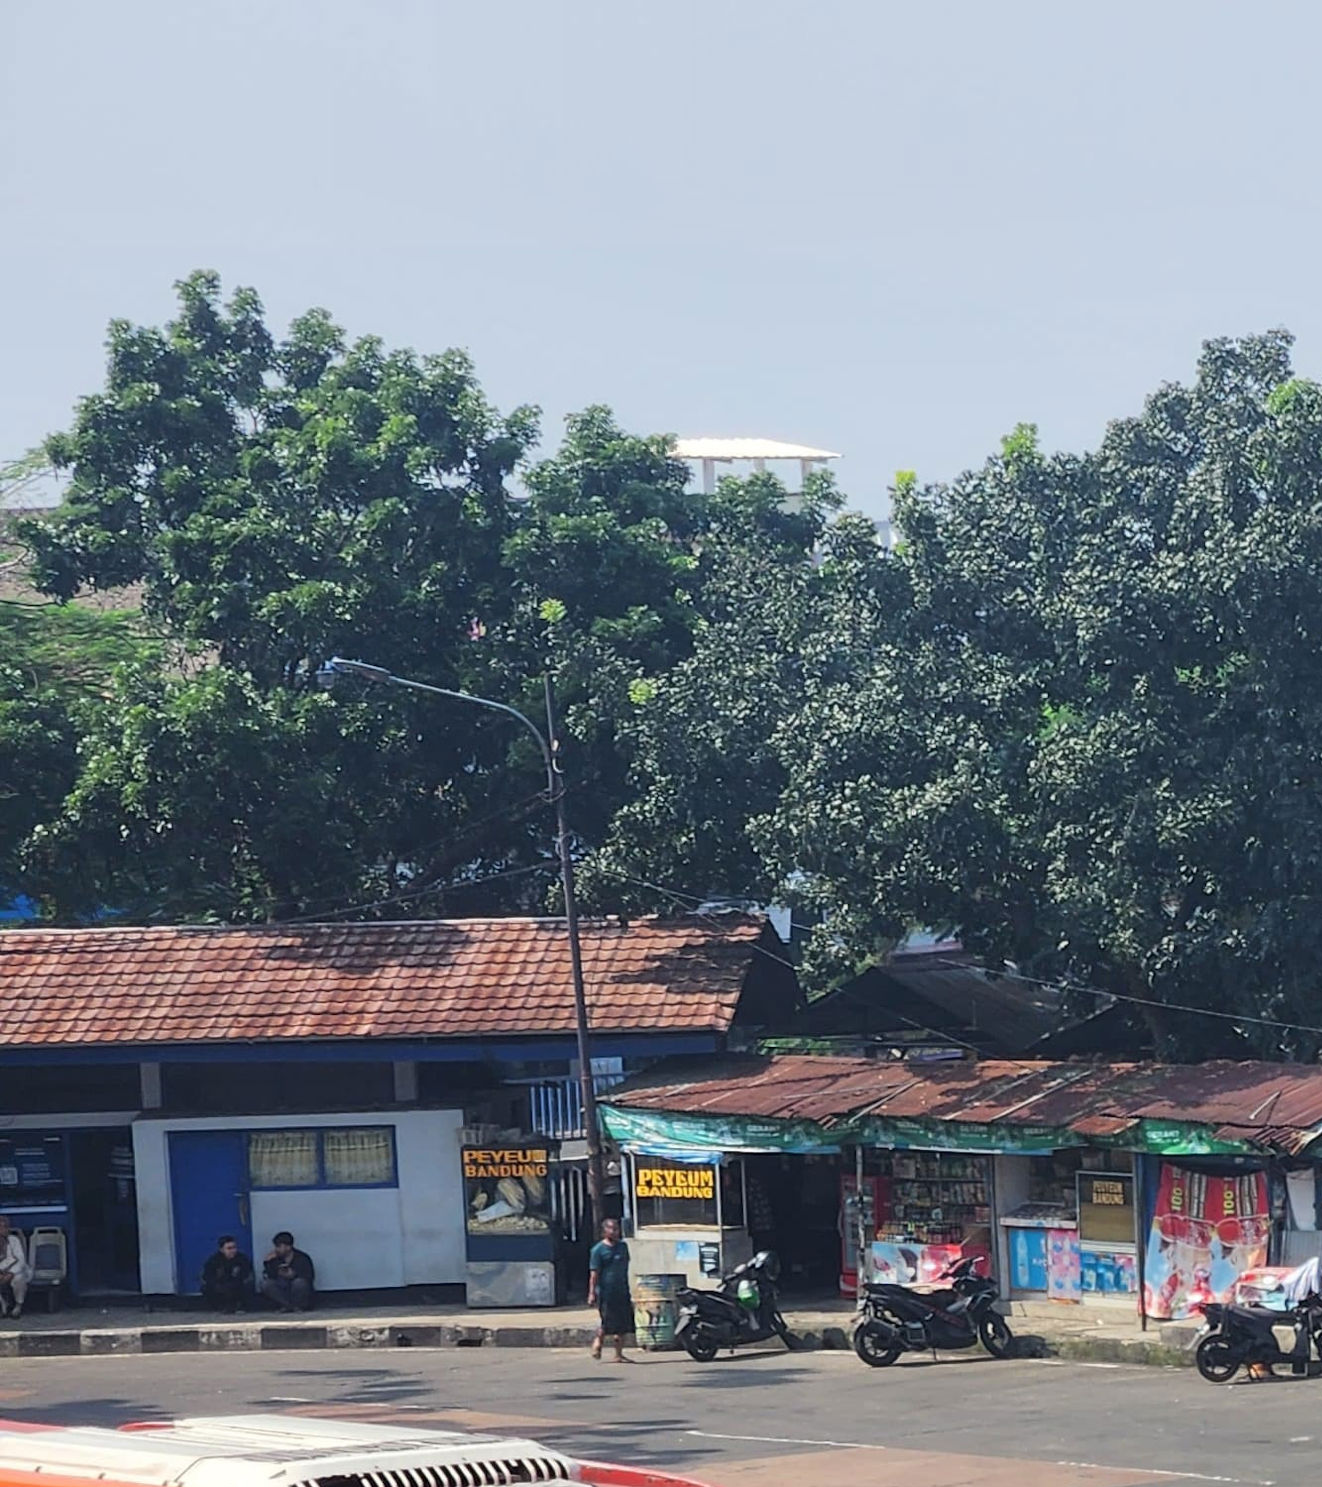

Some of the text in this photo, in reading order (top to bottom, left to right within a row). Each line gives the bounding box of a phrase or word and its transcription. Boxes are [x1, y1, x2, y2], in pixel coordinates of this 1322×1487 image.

[464, 1164, 548, 1178] BANDUNG
[638, 1168, 714, 1187] PEYEUM
[637, 1186, 713, 1199] BANDUNG
